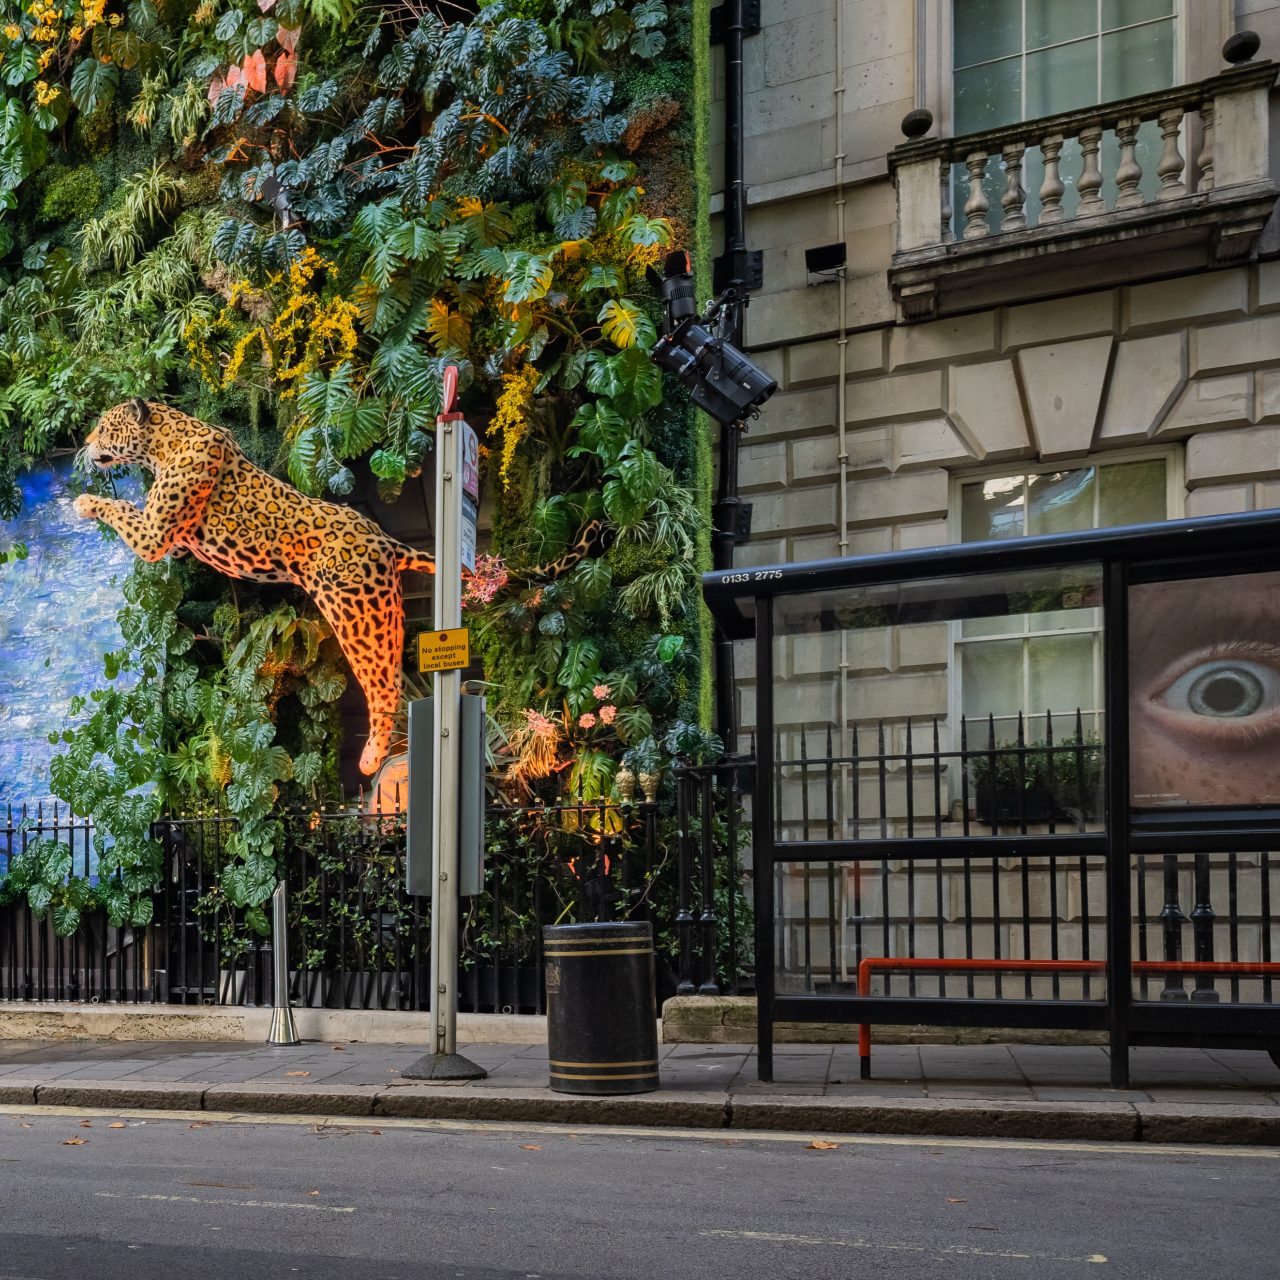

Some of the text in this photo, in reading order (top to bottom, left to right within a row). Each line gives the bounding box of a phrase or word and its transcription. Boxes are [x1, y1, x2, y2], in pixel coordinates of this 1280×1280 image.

[722, 569, 783, 584] 0133 2775
[434, 644, 466, 653] stopping
[432, 652, 456, 660] except
